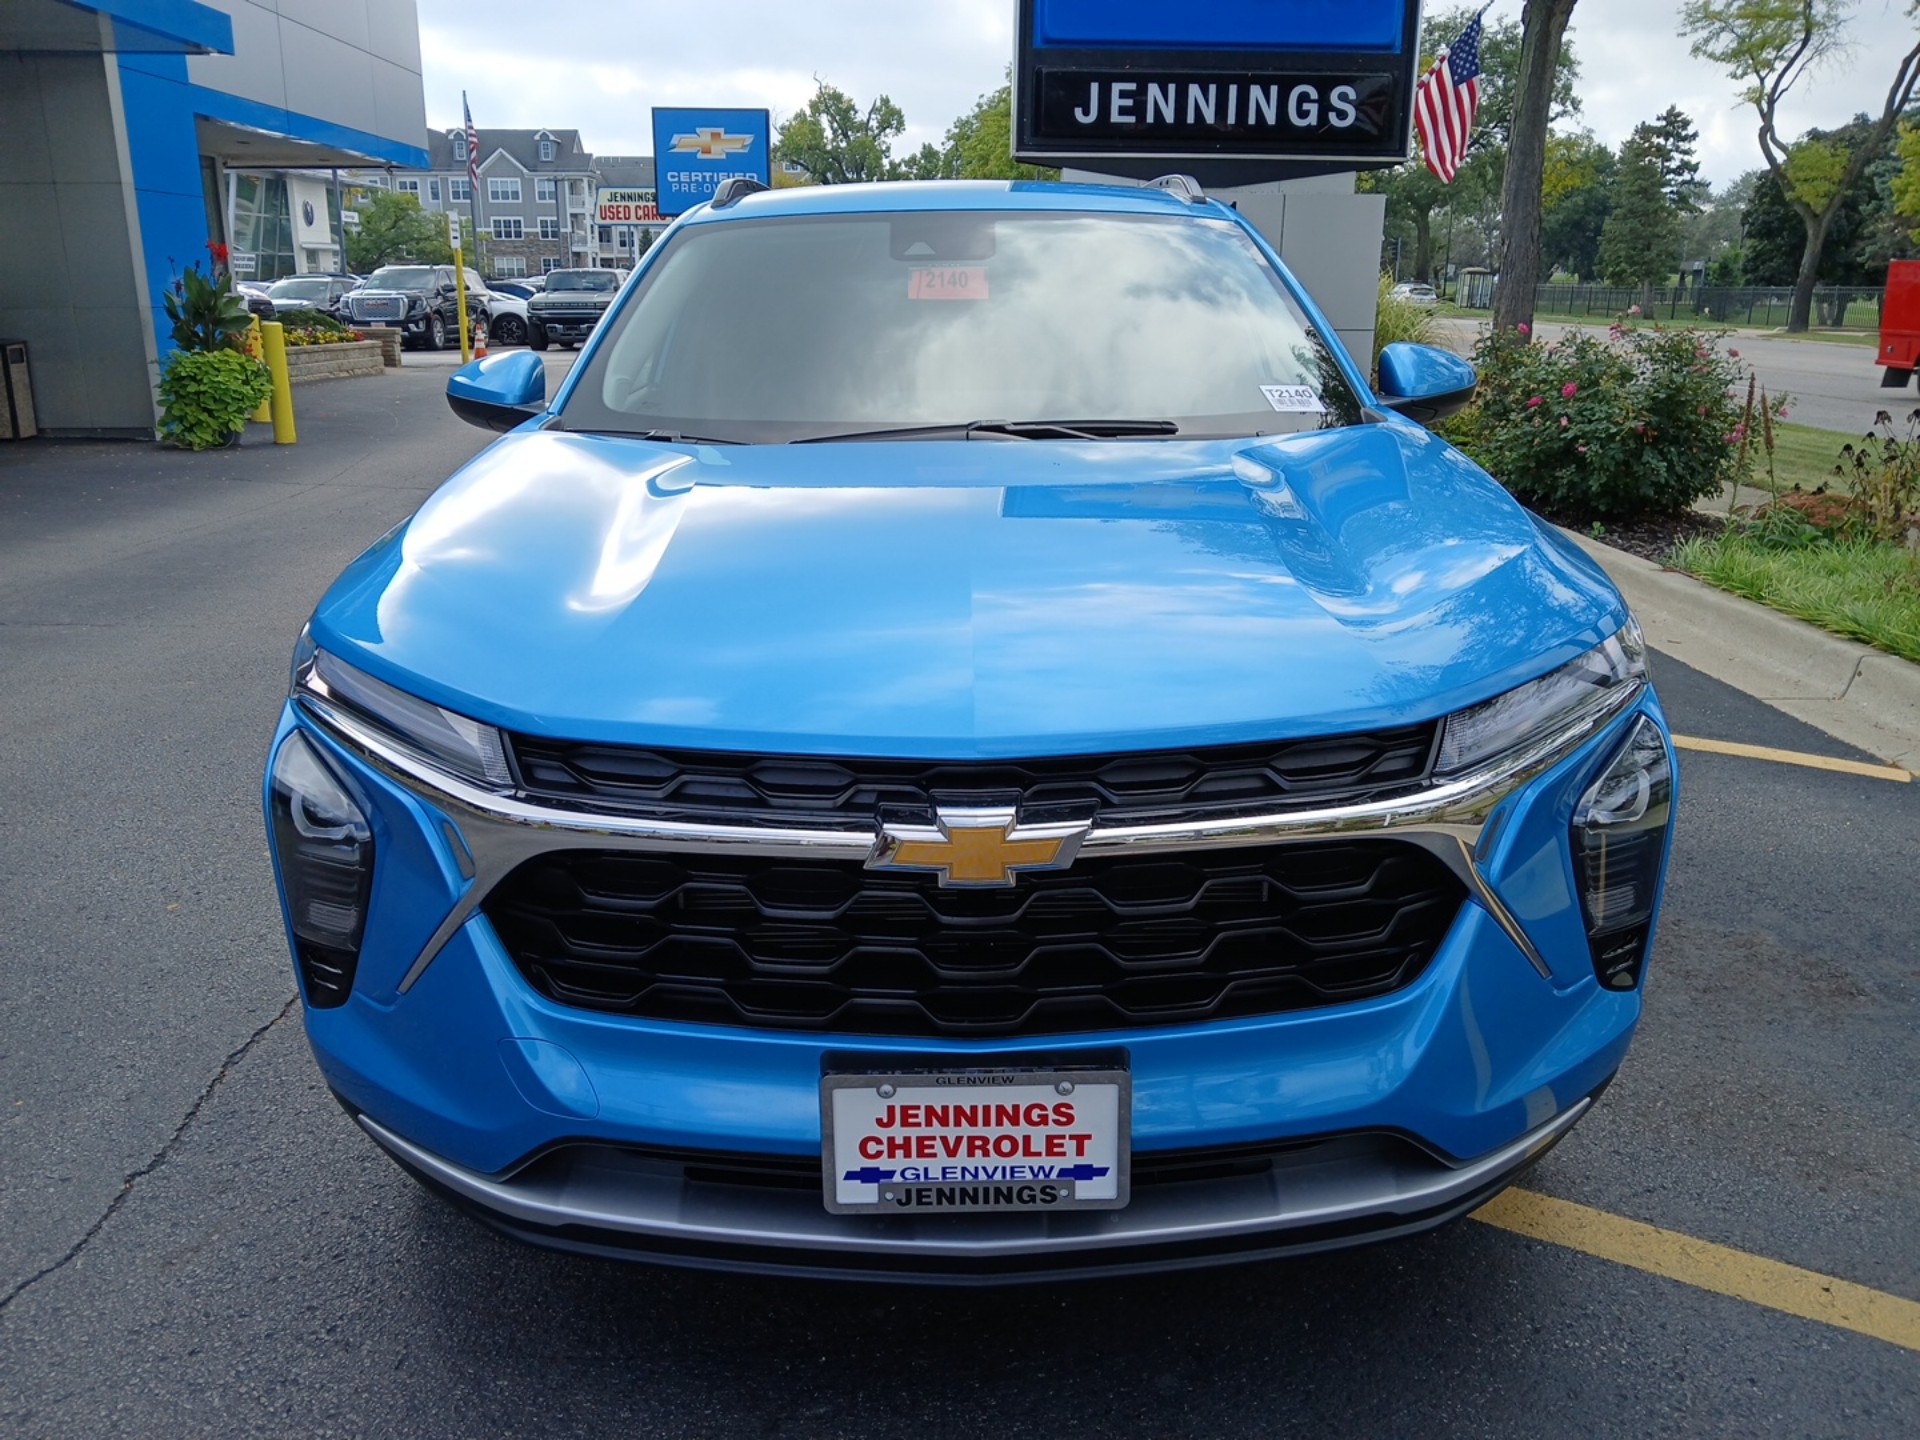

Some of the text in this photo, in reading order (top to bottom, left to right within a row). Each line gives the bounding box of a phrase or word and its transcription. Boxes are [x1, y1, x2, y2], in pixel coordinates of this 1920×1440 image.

[1074, 82, 1357, 127] JENNINGS
[607, 191, 656, 203] JENNINGS
[599, 205, 666, 221] USED CAR
[925, 270, 969, 289] 2140
[1265, 388, 1312, 398] T2140
[935, 1076, 1014, 1085] GLENVIEW
[875, 1103, 1075, 1128] JENNINGS
[858, 1134, 1092, 1159] CHEVROLET
[900, 1165, 1055, 1181] GLENVIEW
[896, 1185, 1057, 1207] JENNINGS
